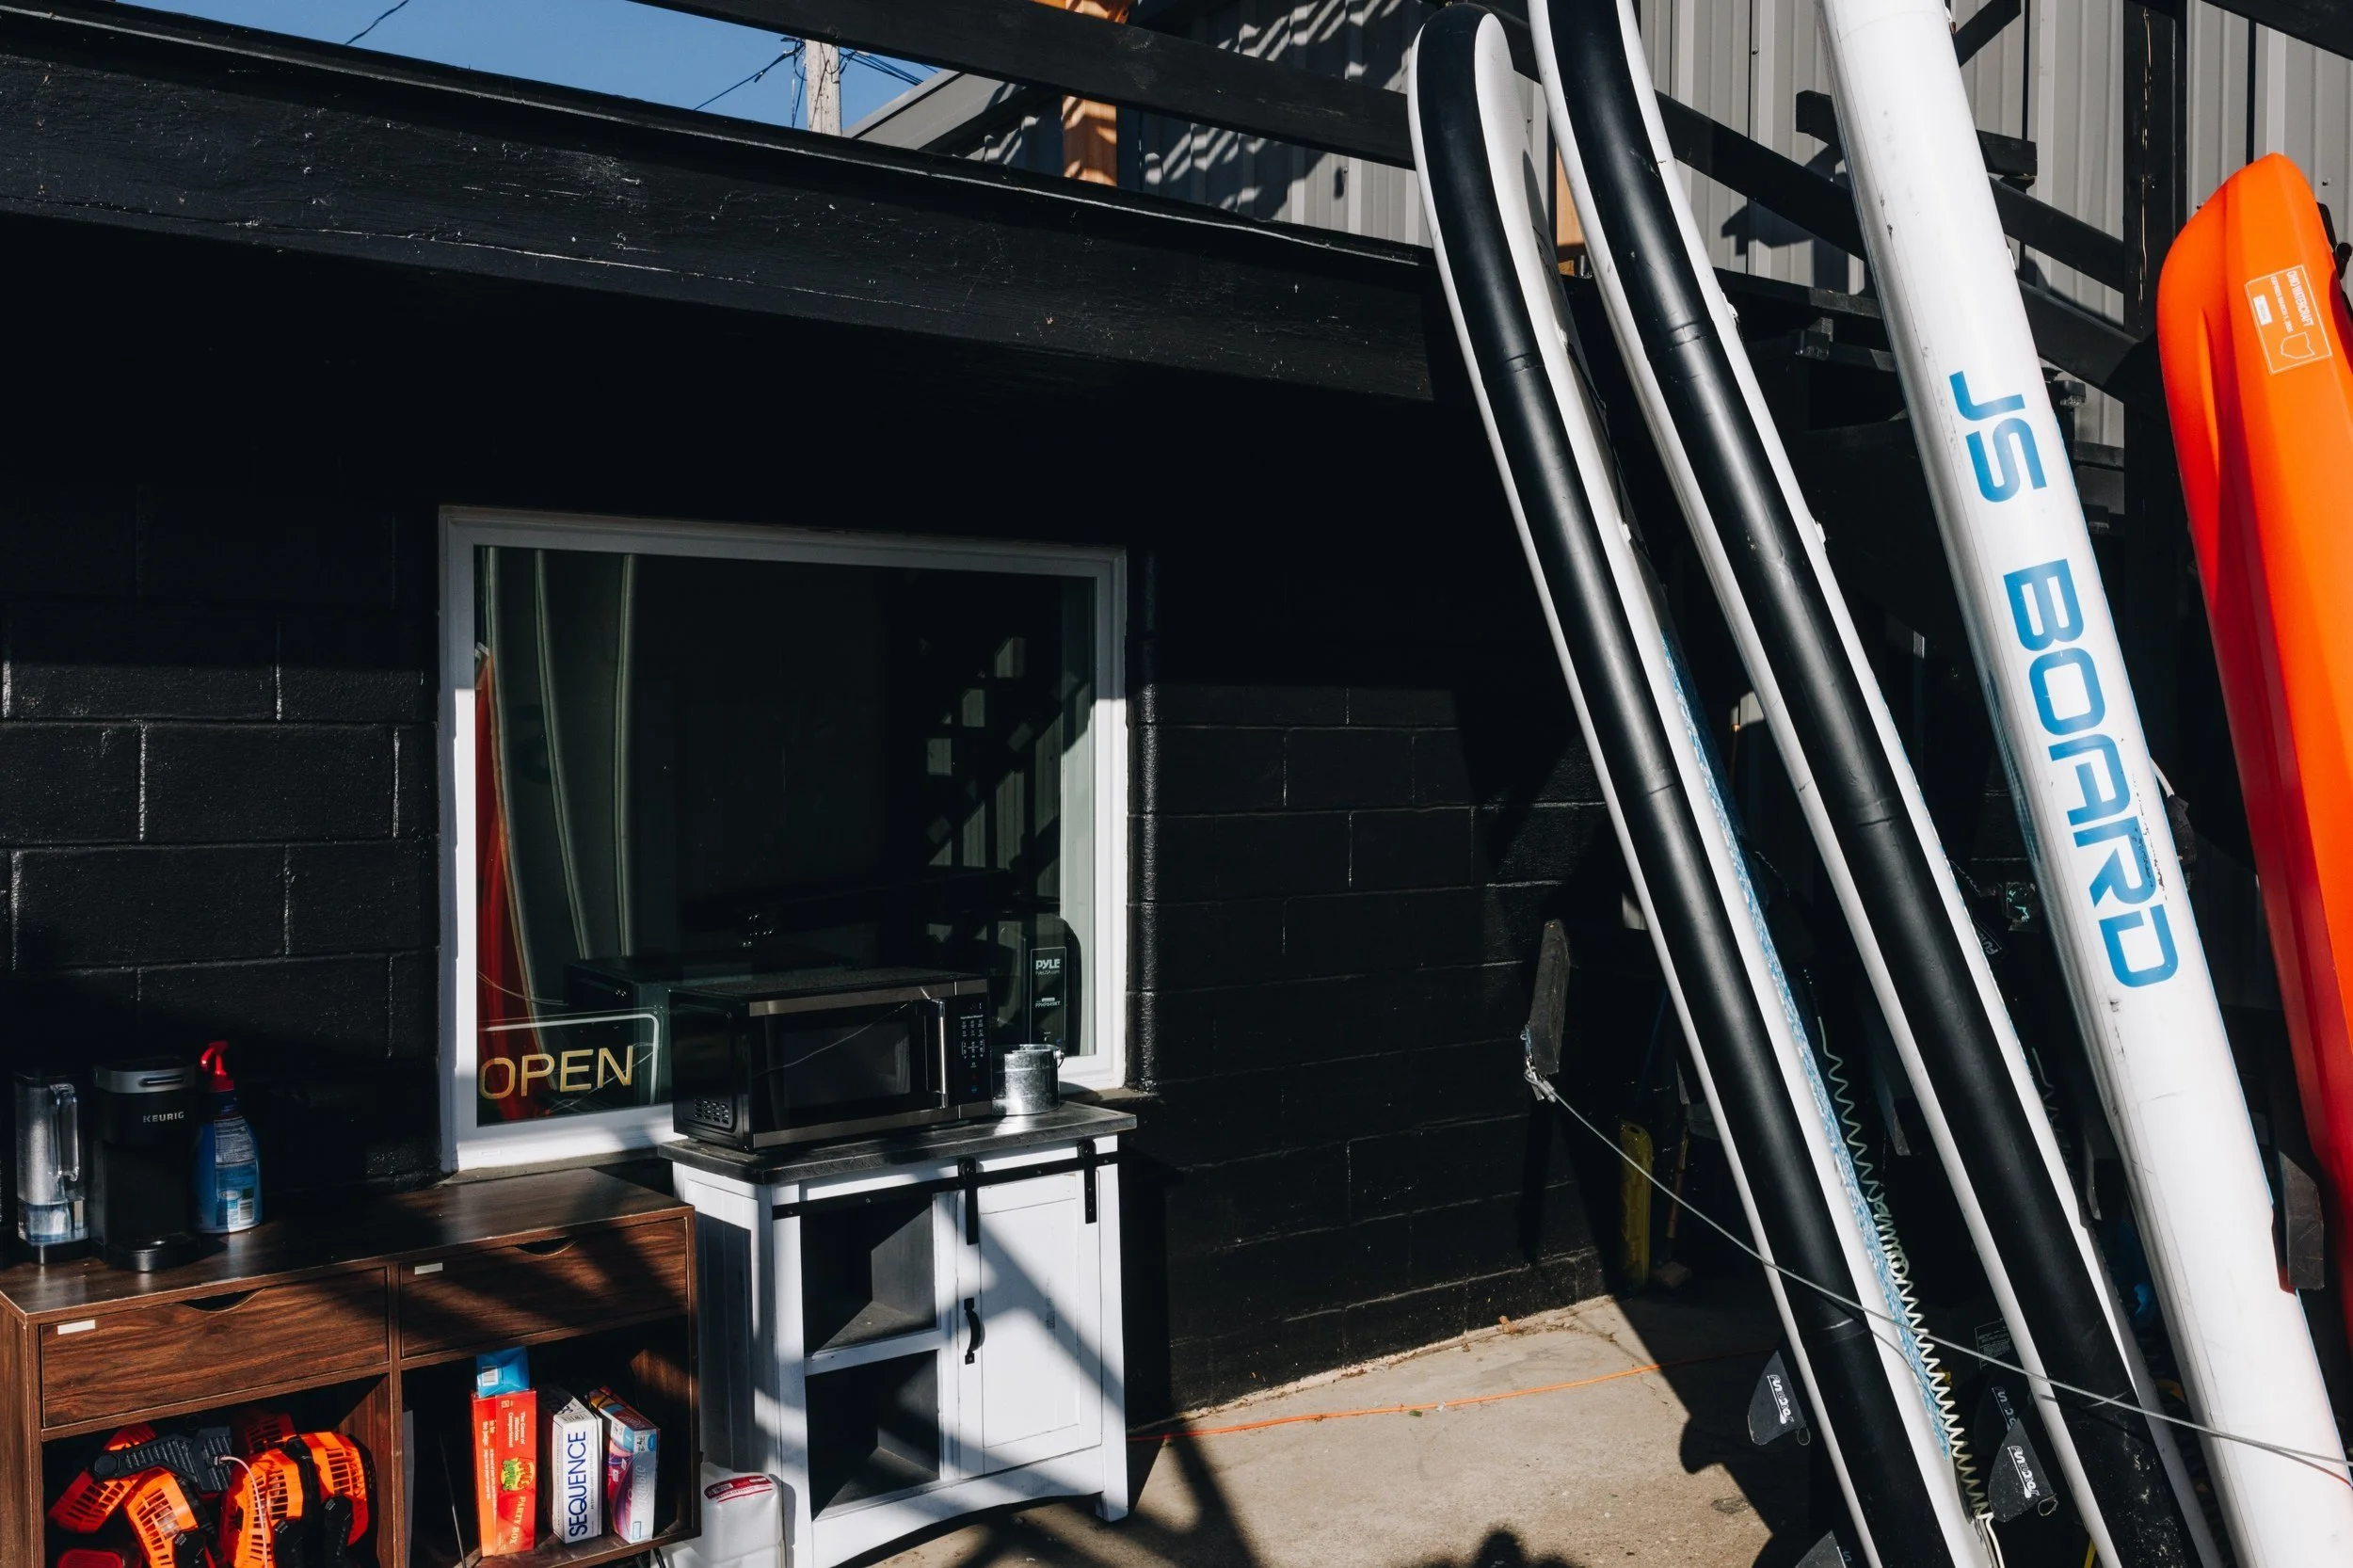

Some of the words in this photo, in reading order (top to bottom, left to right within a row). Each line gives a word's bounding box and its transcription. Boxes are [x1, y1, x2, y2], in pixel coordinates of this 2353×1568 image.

[2287, 270, 2300, 287] OHIO
[2292, 284, 2314, 327] WATERCRAFT
[1948, 370, 2047, 504] JS
[2003, 558, 2179, 988] BOARD
[1035, 959, 1061, 969] PYLE
[478, 1045, 633, 1100] OPEN
[142, 1110, 184, 1124] KEURIG
[568, 1431, 588, 1537] SEQUENCE
[513, 1496, 526, 1525] PARTY
[509, 1526, 520, 1544] BOX
